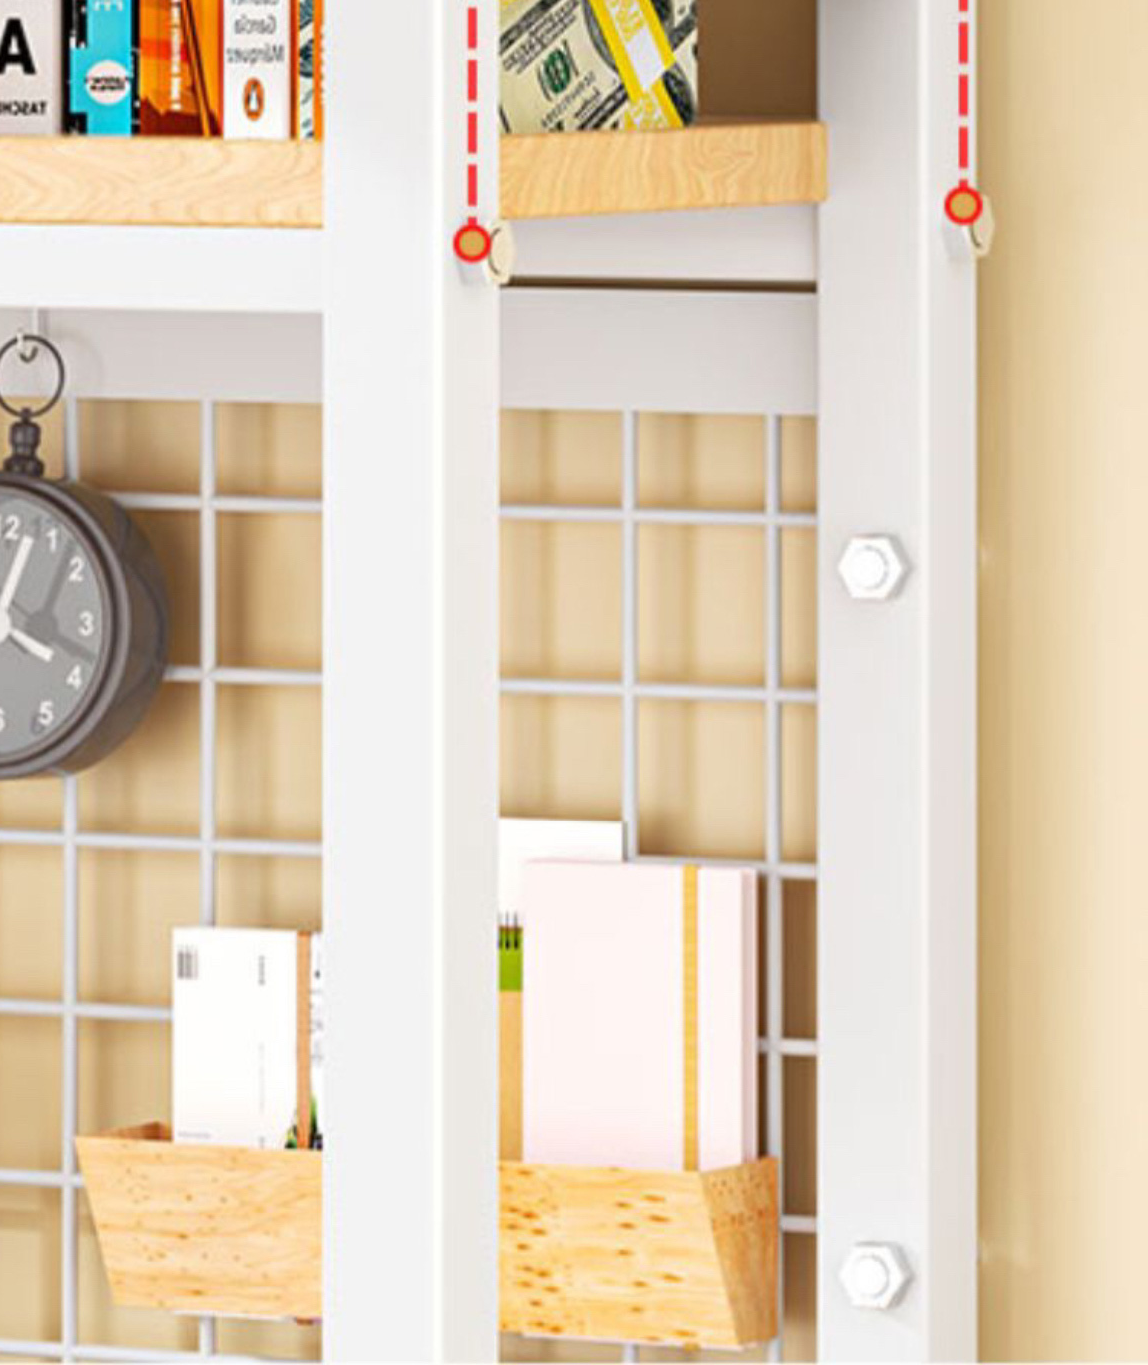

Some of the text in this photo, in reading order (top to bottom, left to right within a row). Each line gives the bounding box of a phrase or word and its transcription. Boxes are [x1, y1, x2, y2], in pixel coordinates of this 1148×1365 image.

[46, 528, 58, 551] 1
[69, 557, 84, 582] 2
[79, 612, 93, 636] 3
[66, 664, 82, 691] 4
[38, 701, 54, 726] 5
